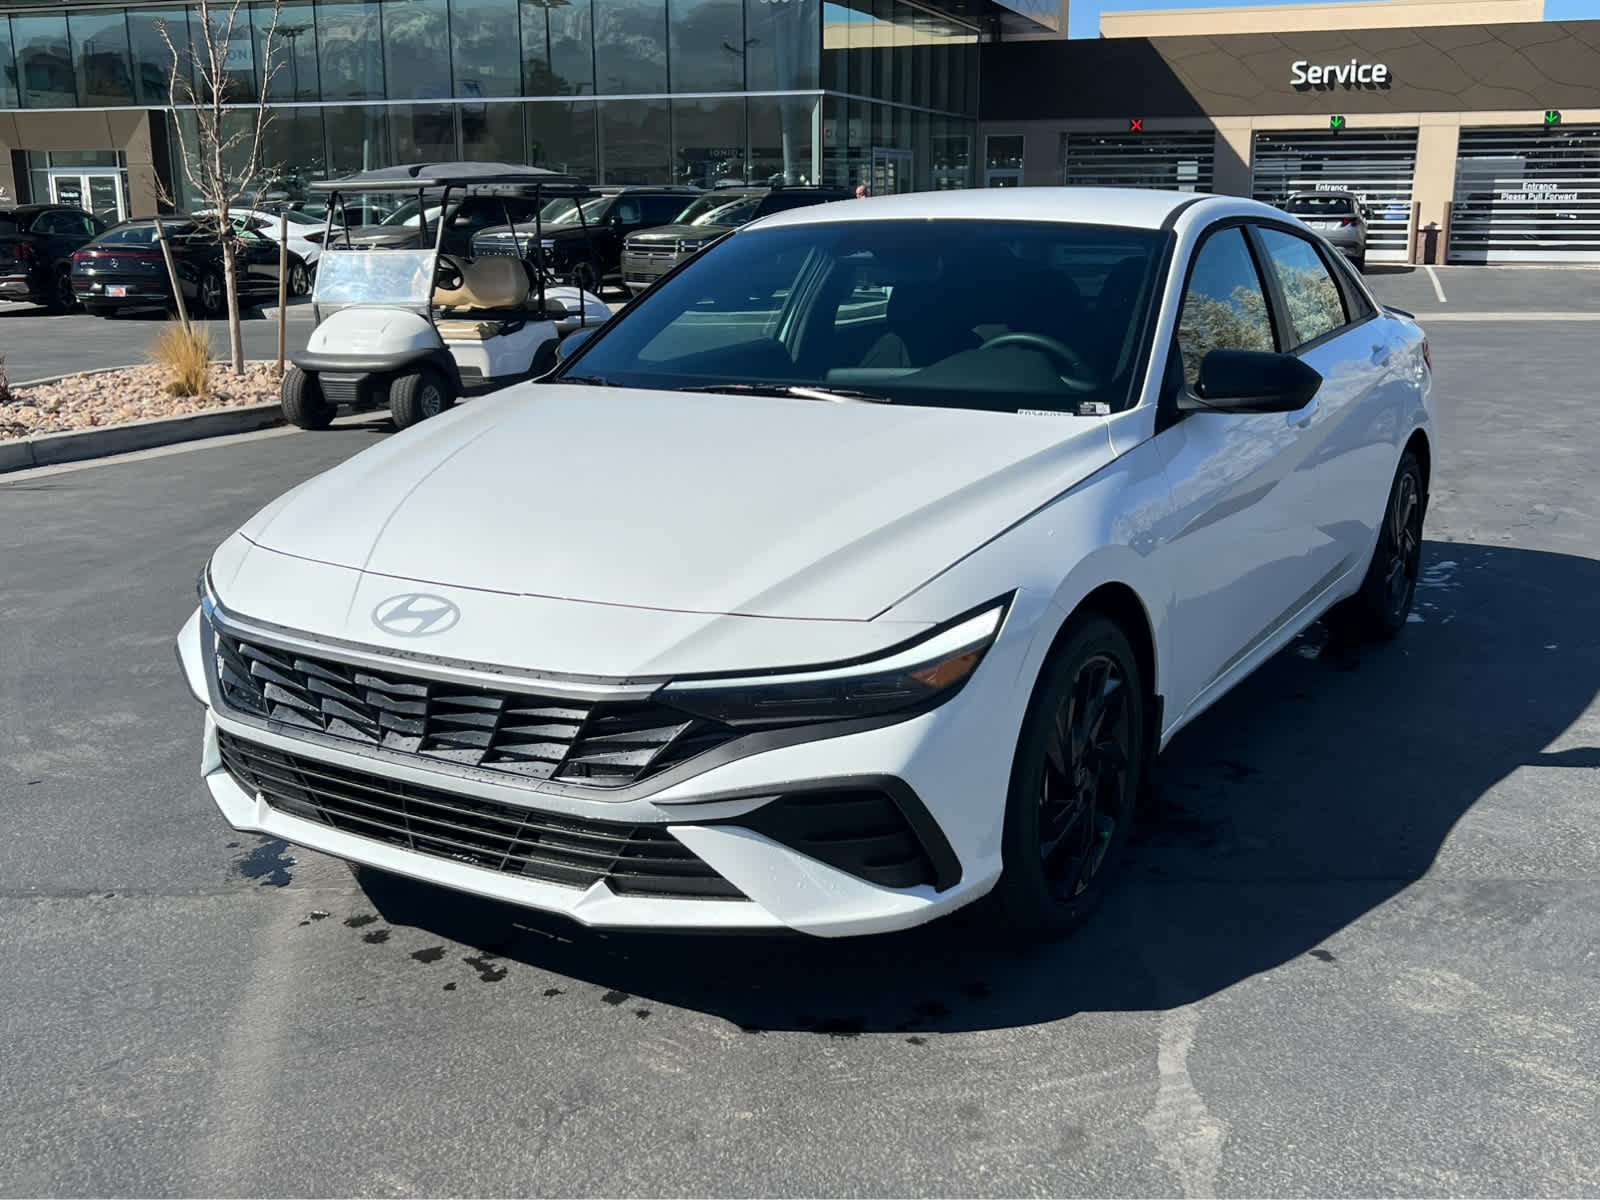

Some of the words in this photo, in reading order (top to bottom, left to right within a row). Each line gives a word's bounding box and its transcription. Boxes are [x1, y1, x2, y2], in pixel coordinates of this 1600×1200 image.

[1290, 59, 1387, 84] Service
[1315, 183, 1348, 192] Entrance
[1522, 182, 1558, 192] Entrance
[1501, 192, 1526, 200] Please
[1527, 192, 1543, 200] Pull
[1544, 192, 1577, 200] Forward
